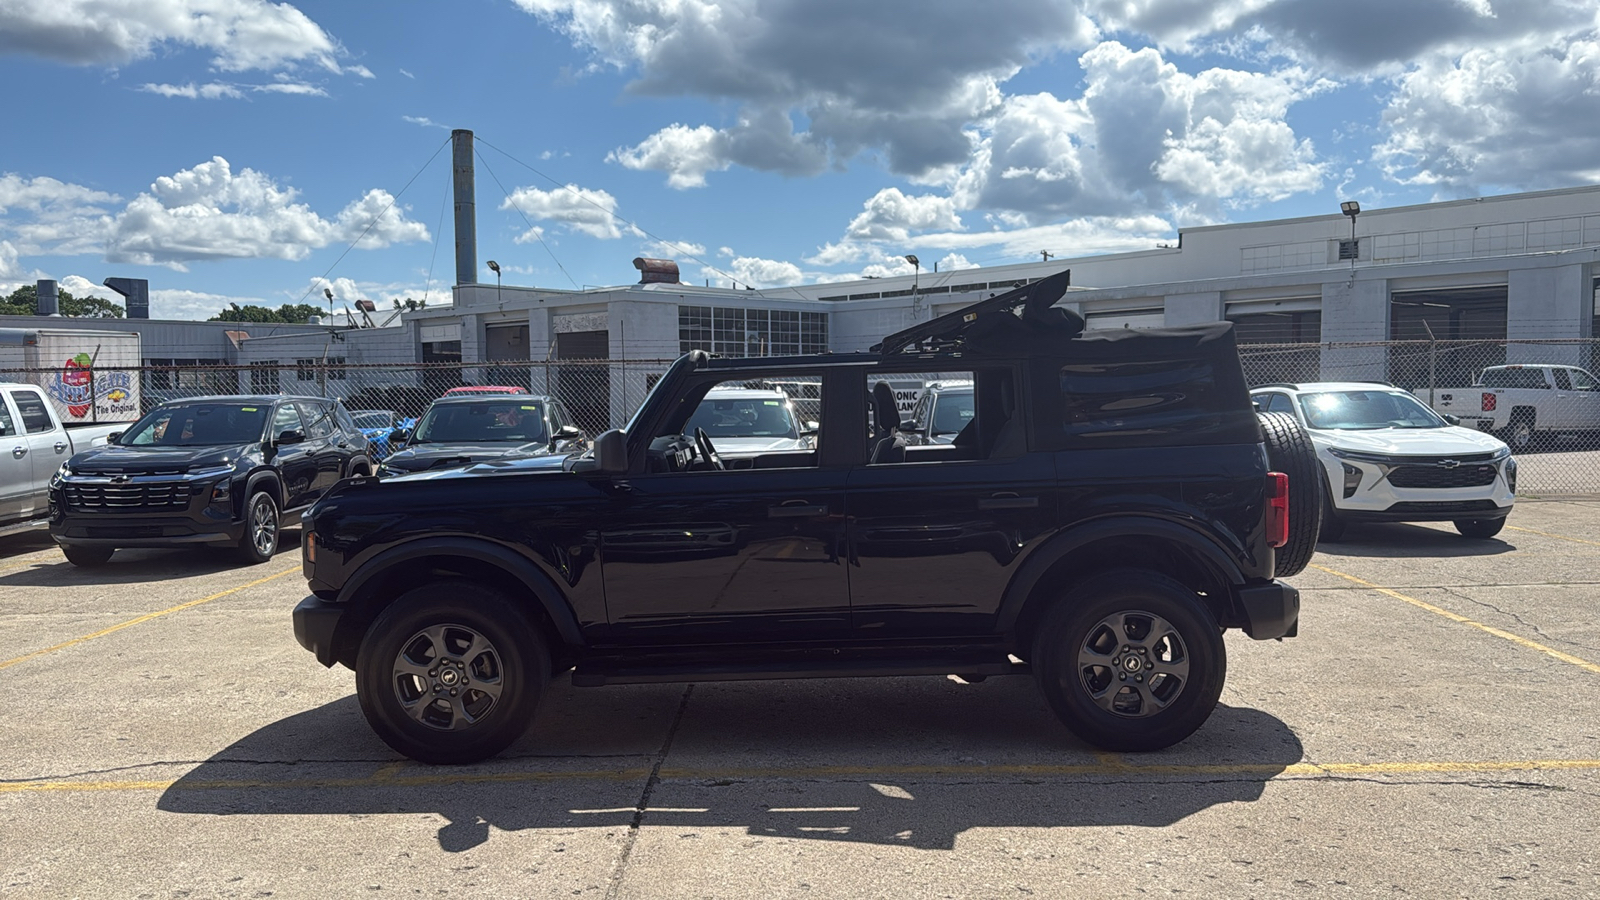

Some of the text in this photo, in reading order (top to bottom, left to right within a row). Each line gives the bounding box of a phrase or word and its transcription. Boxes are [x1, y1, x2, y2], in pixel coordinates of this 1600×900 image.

[50, 371, 131, 403] APPLGATE
[895, 391, 917, 400] ONIC
[96, 405, 109, 415] The
